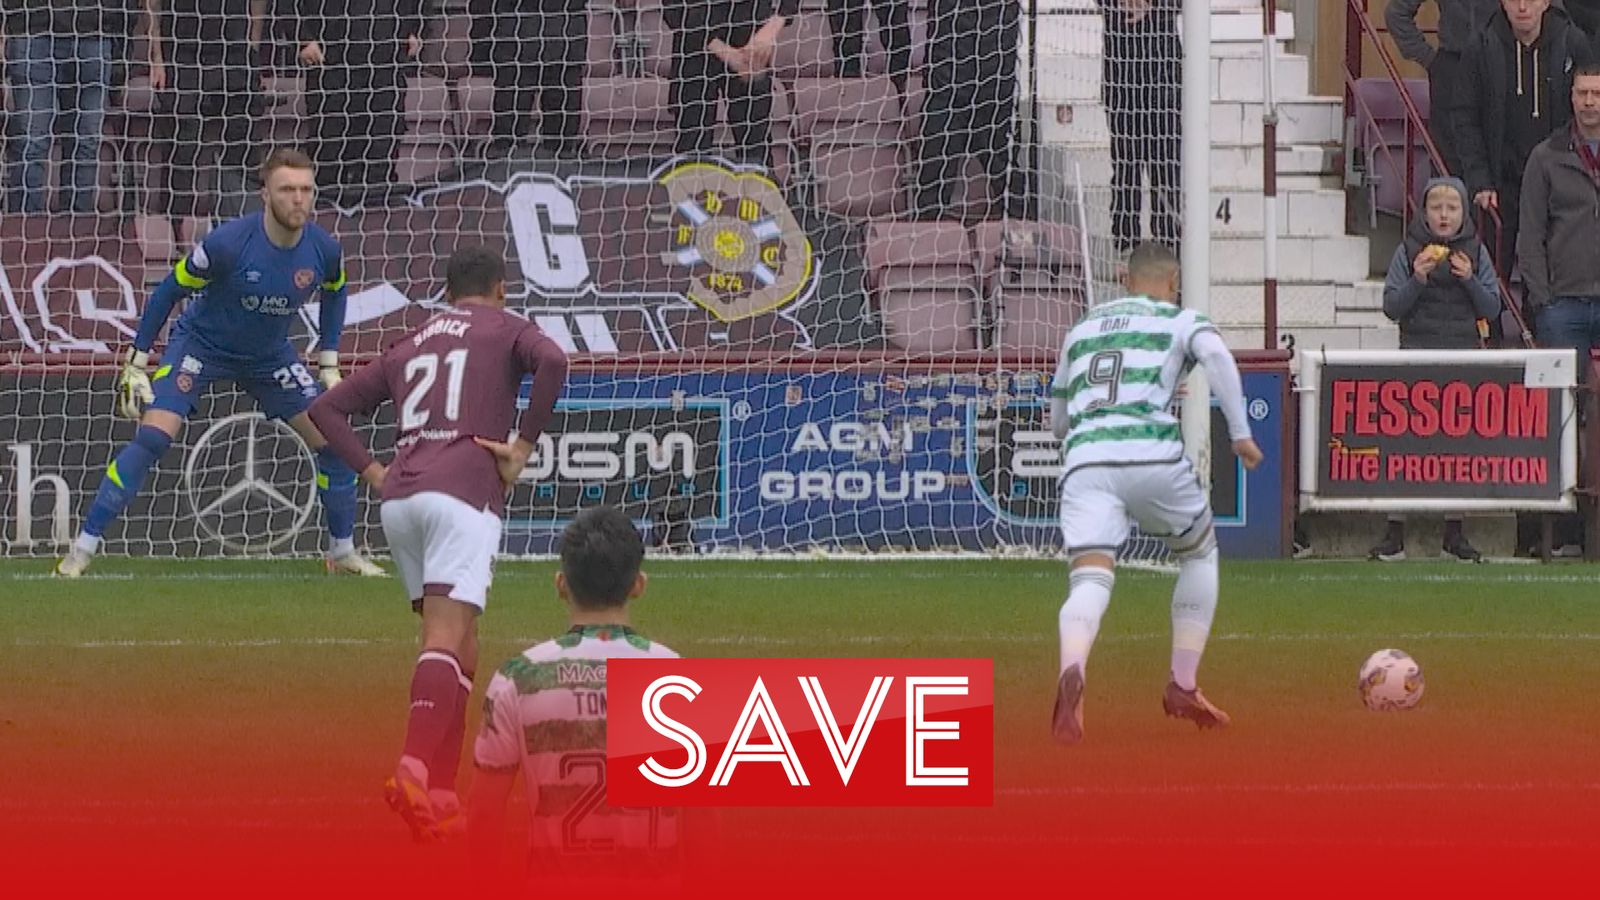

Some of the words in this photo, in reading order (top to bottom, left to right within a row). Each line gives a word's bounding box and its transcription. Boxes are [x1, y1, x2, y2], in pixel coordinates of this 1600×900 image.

[1215, 197, 1232, 225] 4
[505, 180, 591, 292] G
[1099, 317, 1131, 333] IDAH
[273, 362, 315, 389] 28
[401, 348, 469, 431] 21
[1085, 350, 1123, 412] 9
[1331, 380, 1548, 438] FESSCOM
[791, 421, 914, 451] AGM
[1330, 446, 1379, 481] fire
[1386, 453, 1548, 484] PROTECTION
[761, 471, 946, 500] GROUP
